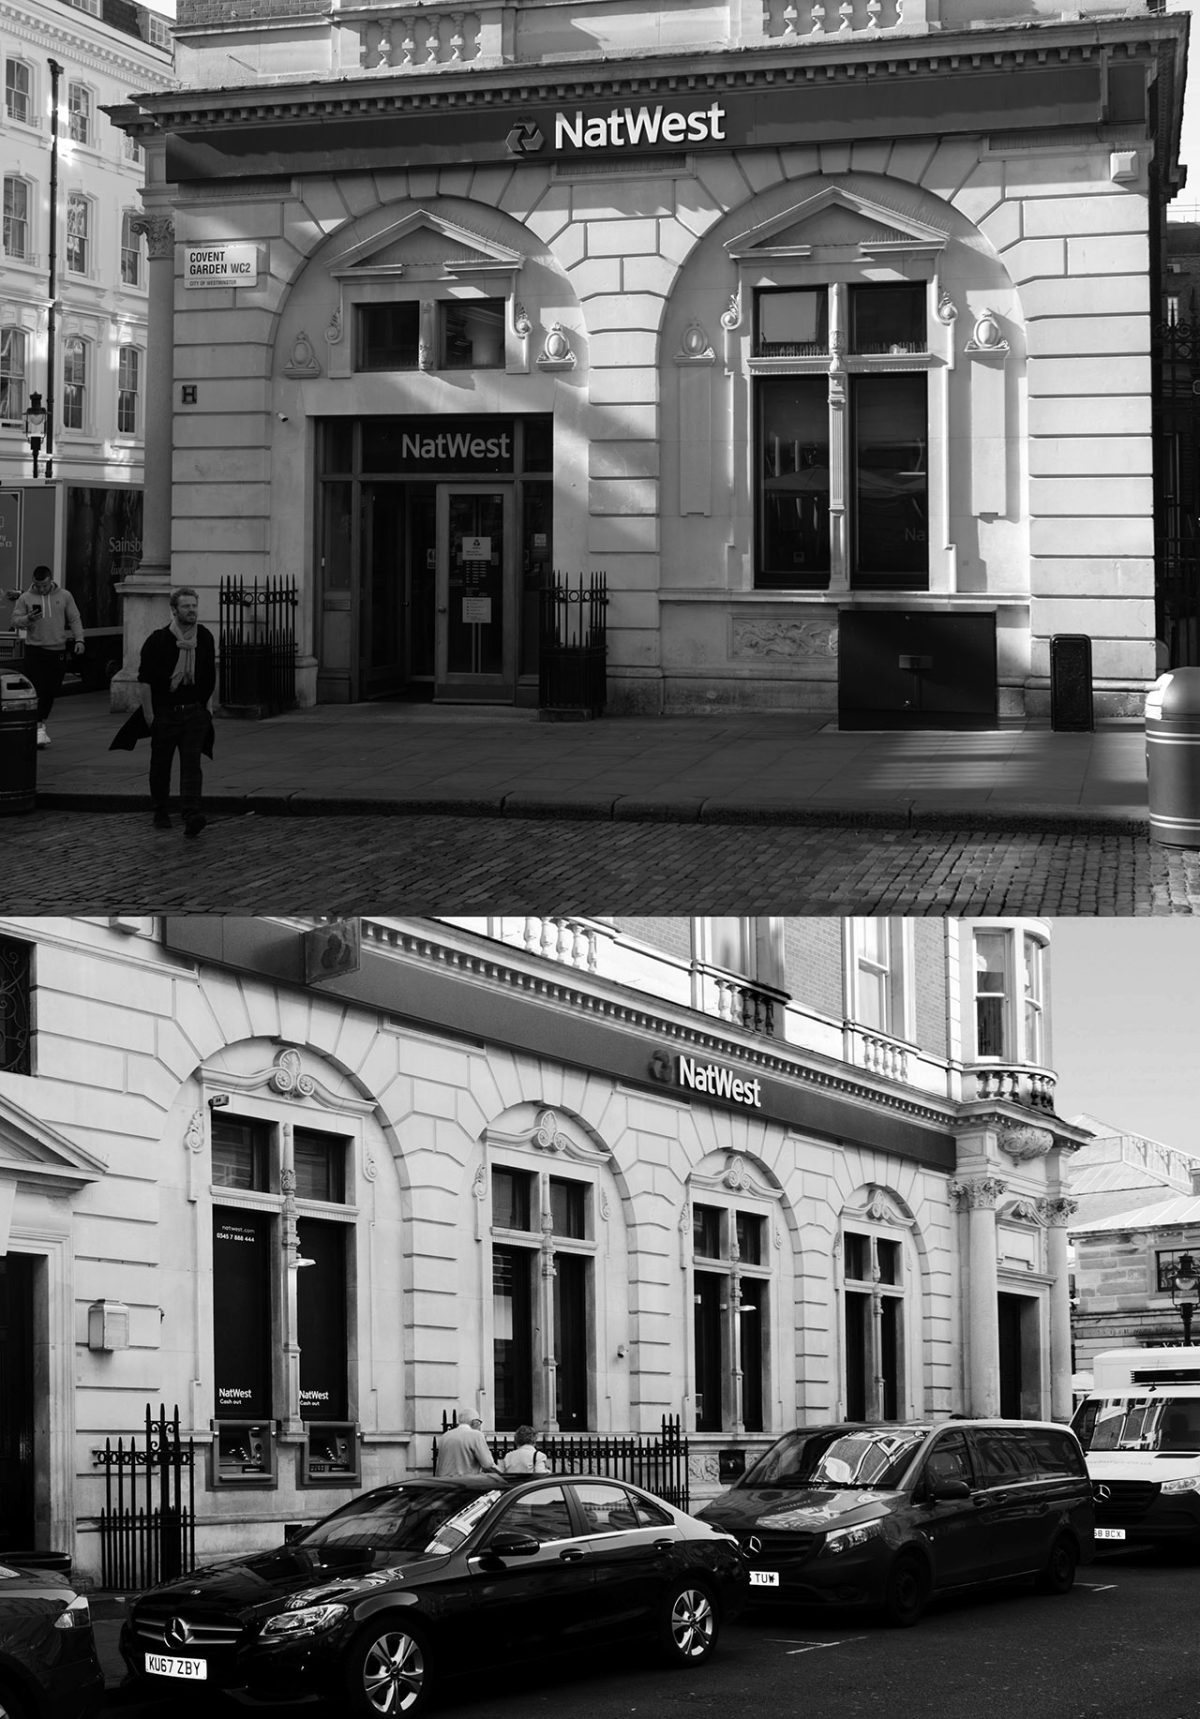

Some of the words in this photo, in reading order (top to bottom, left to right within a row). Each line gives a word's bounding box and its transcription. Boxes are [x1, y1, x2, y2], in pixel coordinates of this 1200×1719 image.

[555, 101, 726, 149] NatWest
[190, 251, 226, 263] COVENT
[190, 263, 228, 275] GARDEN
[230, 262, 251, 274] WC2
[402, 433, 510, 458] NatWest
[108, 536, 143, 552] Sainsb
[680, 1055, 761, 1107] NatWest
[221, 1225, 256, 1234] natwest.com
[219, 1388, 252, 1399] NatWest
[299, 1390, 329, 1400] NatWest
[149, 1656, 174, 1673] KU67
[177, 1660, 200, 1676] ZBY
